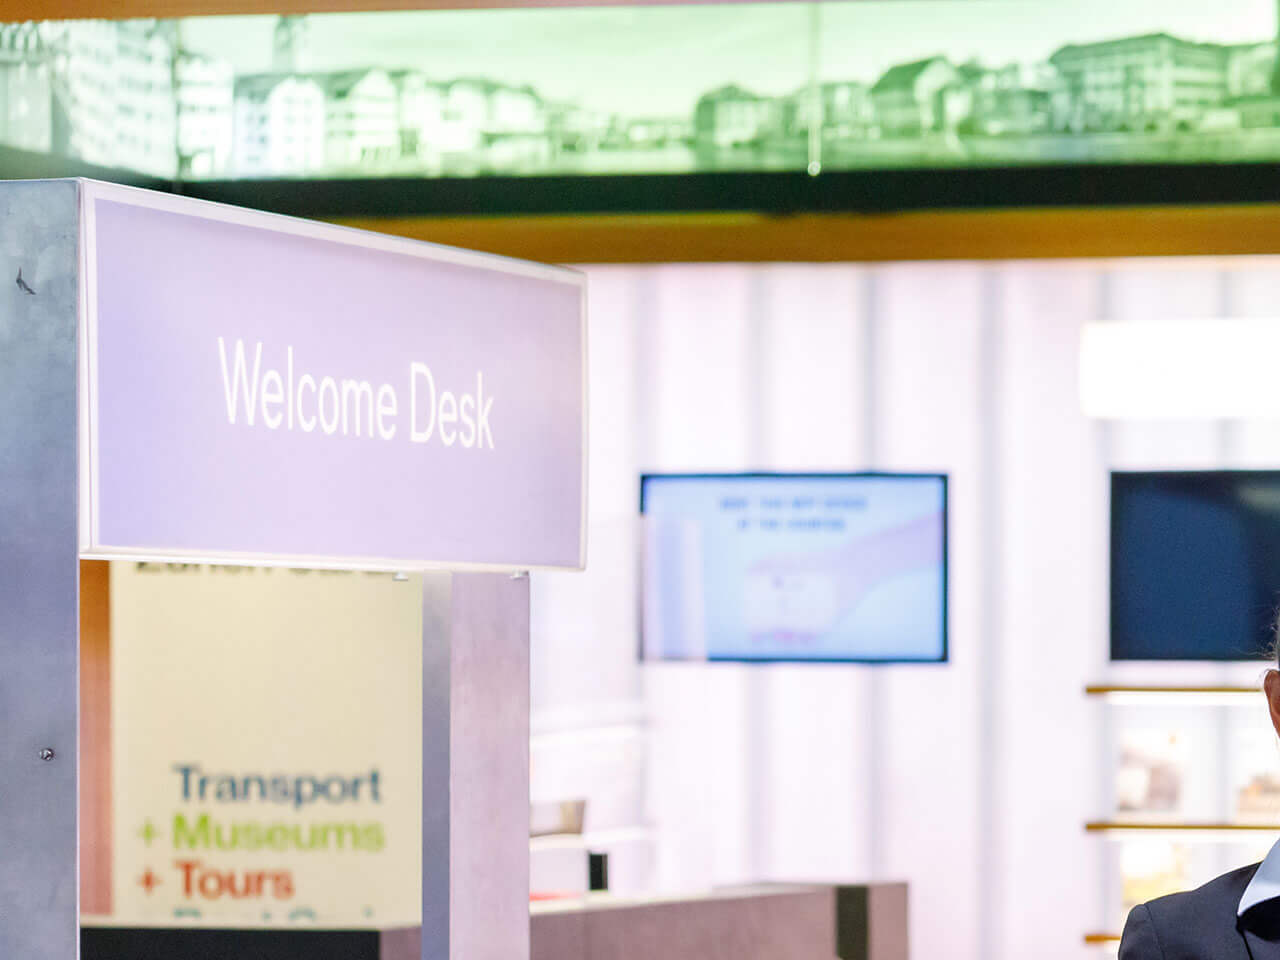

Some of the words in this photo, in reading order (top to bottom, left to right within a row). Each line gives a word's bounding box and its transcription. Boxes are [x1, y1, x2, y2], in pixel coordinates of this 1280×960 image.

[217, 336, 397, 440] Welcome
[410, 361, 495, 449] Desk
[174, 765, 382, 810] Transport
[173, 814, 385, 851] Museums
[175, 860, 295, 899] Tours
